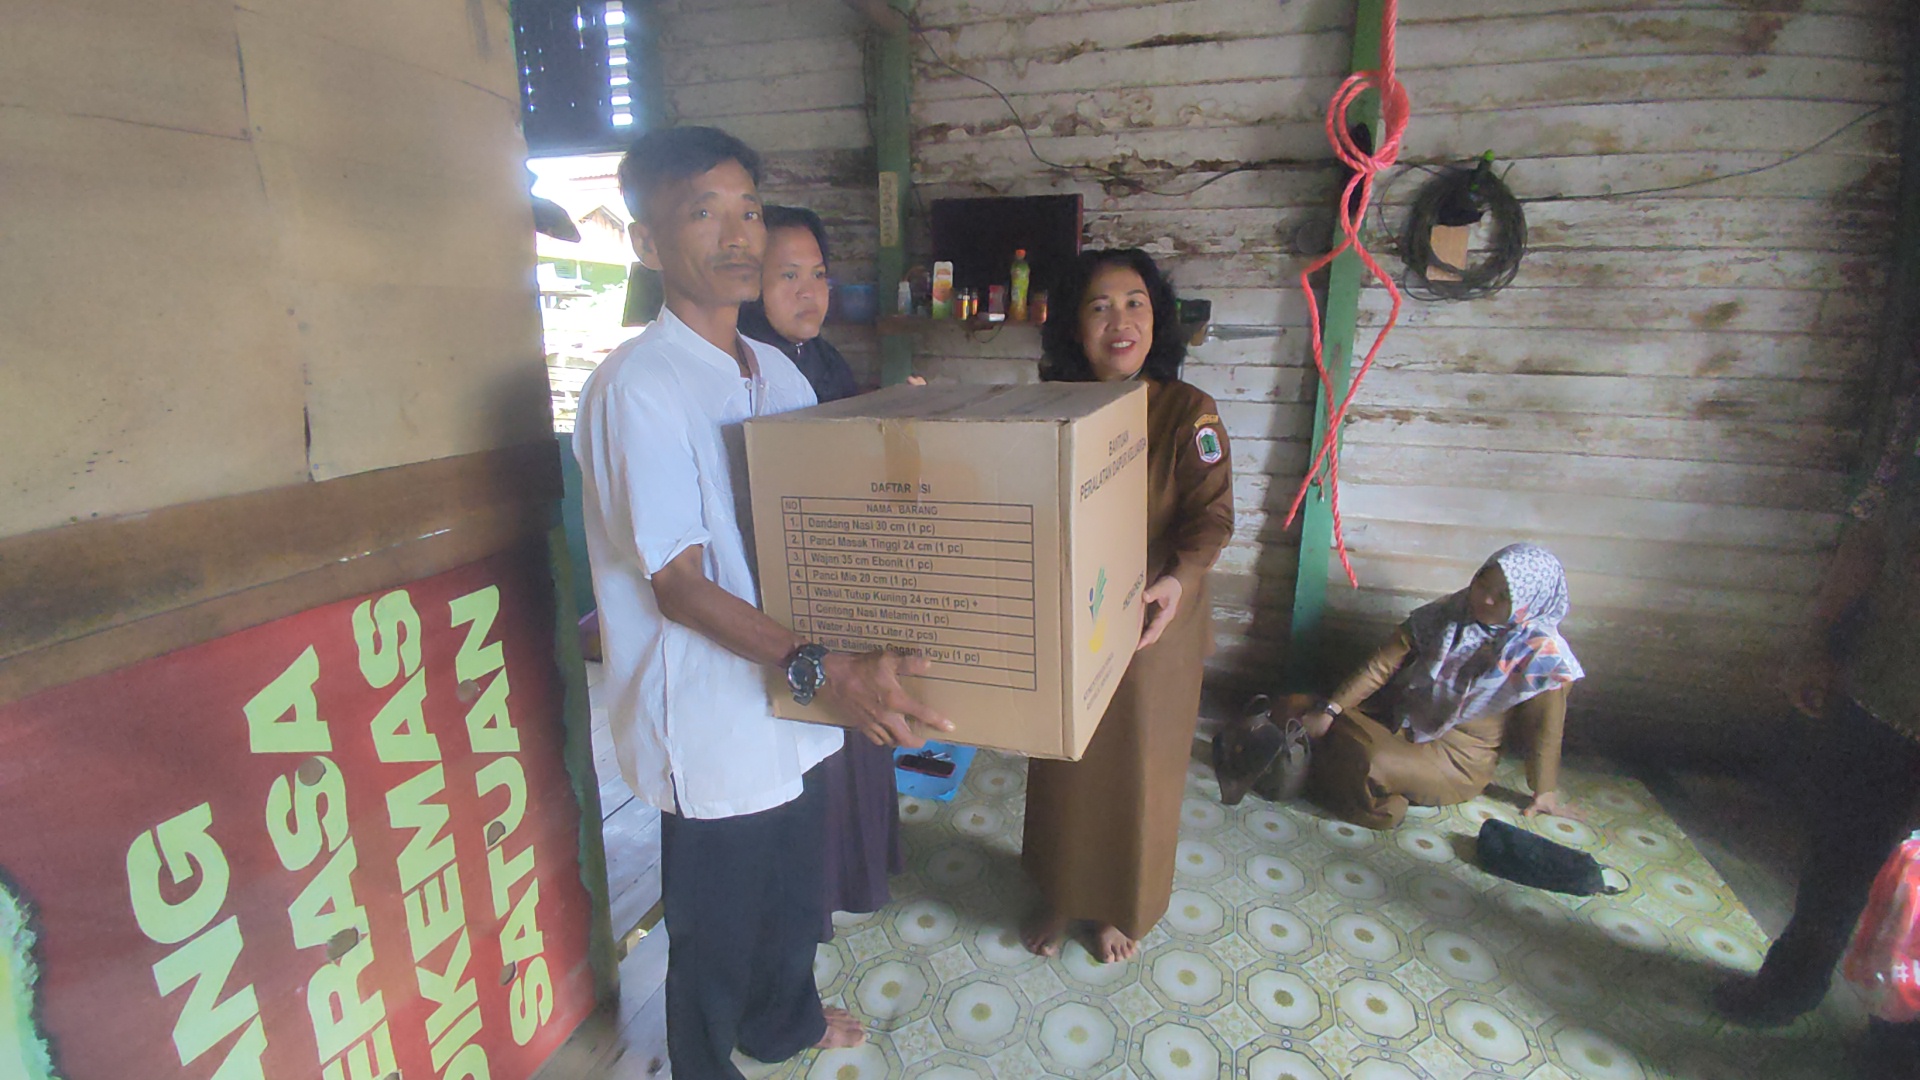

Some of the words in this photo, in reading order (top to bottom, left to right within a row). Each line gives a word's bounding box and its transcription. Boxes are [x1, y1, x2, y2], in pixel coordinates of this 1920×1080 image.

[871, 482, 911, 494] DAFTAR
[918, 483, 931, 494] SI
[785, 501, 797, 510] NO
[866, 504, 892, 513] NAMA
[899, 505, 938, 515] BARANG
[808, 517, 850, 531] Dandang
[852, 520, 873, 530] Nasi
[876, 520, 888, 531] 30
[890, 523, 905, 532] cm
[920, 523, 936, 535] pc)
[809, 535, 836, 546] Panci
[838, 536, 867, 548] Masak
[871, 538, 900, 551] Tinggi
[903, 540, 915, 550] 24
[917, 543, 933, 551] cm
[947, 543, 964, 555] pc)
[811, 552, 839, 565] Wajan
[841, 554, 853, 565] 35
[855, 557, 870, 566] cm
[872, 556, 903, 568] Ebonit
[917, 559, 934, 571] pc)
[812, 570, 839, 581] Panci
[859, 572, 871, 583] 20
[873, 575, 888, 584] cm
[901, 576, 918, 588] pc)
[814, 587, 842, 599] Wakul
[844, 588, 871, 601] Tutup
[873, 591, 908, 605] Kuning
[910, 594, 922, 604] 24
[924, 596, 939, 606] cm
[953, 597, 970, 610] pc)
[815, 603, 854, 617] Centong
[856, 605, 877, 617] Nasi
[880, 608, 920, 621] Melamin
[933, 614, 950, 625] pc)
[817, 619, 843, 631] Water
[846, 622, 863, 635] Jug
[881, 626, 903, 637] Liter
[916, 630, 937, 642] pcs)
[841, 639, 883, 652] Stainless
[925, 647, 950, 660] Kayu
[964, 652, 980, 663] pc)
[448, 584, 554, 1046] SATUAN
